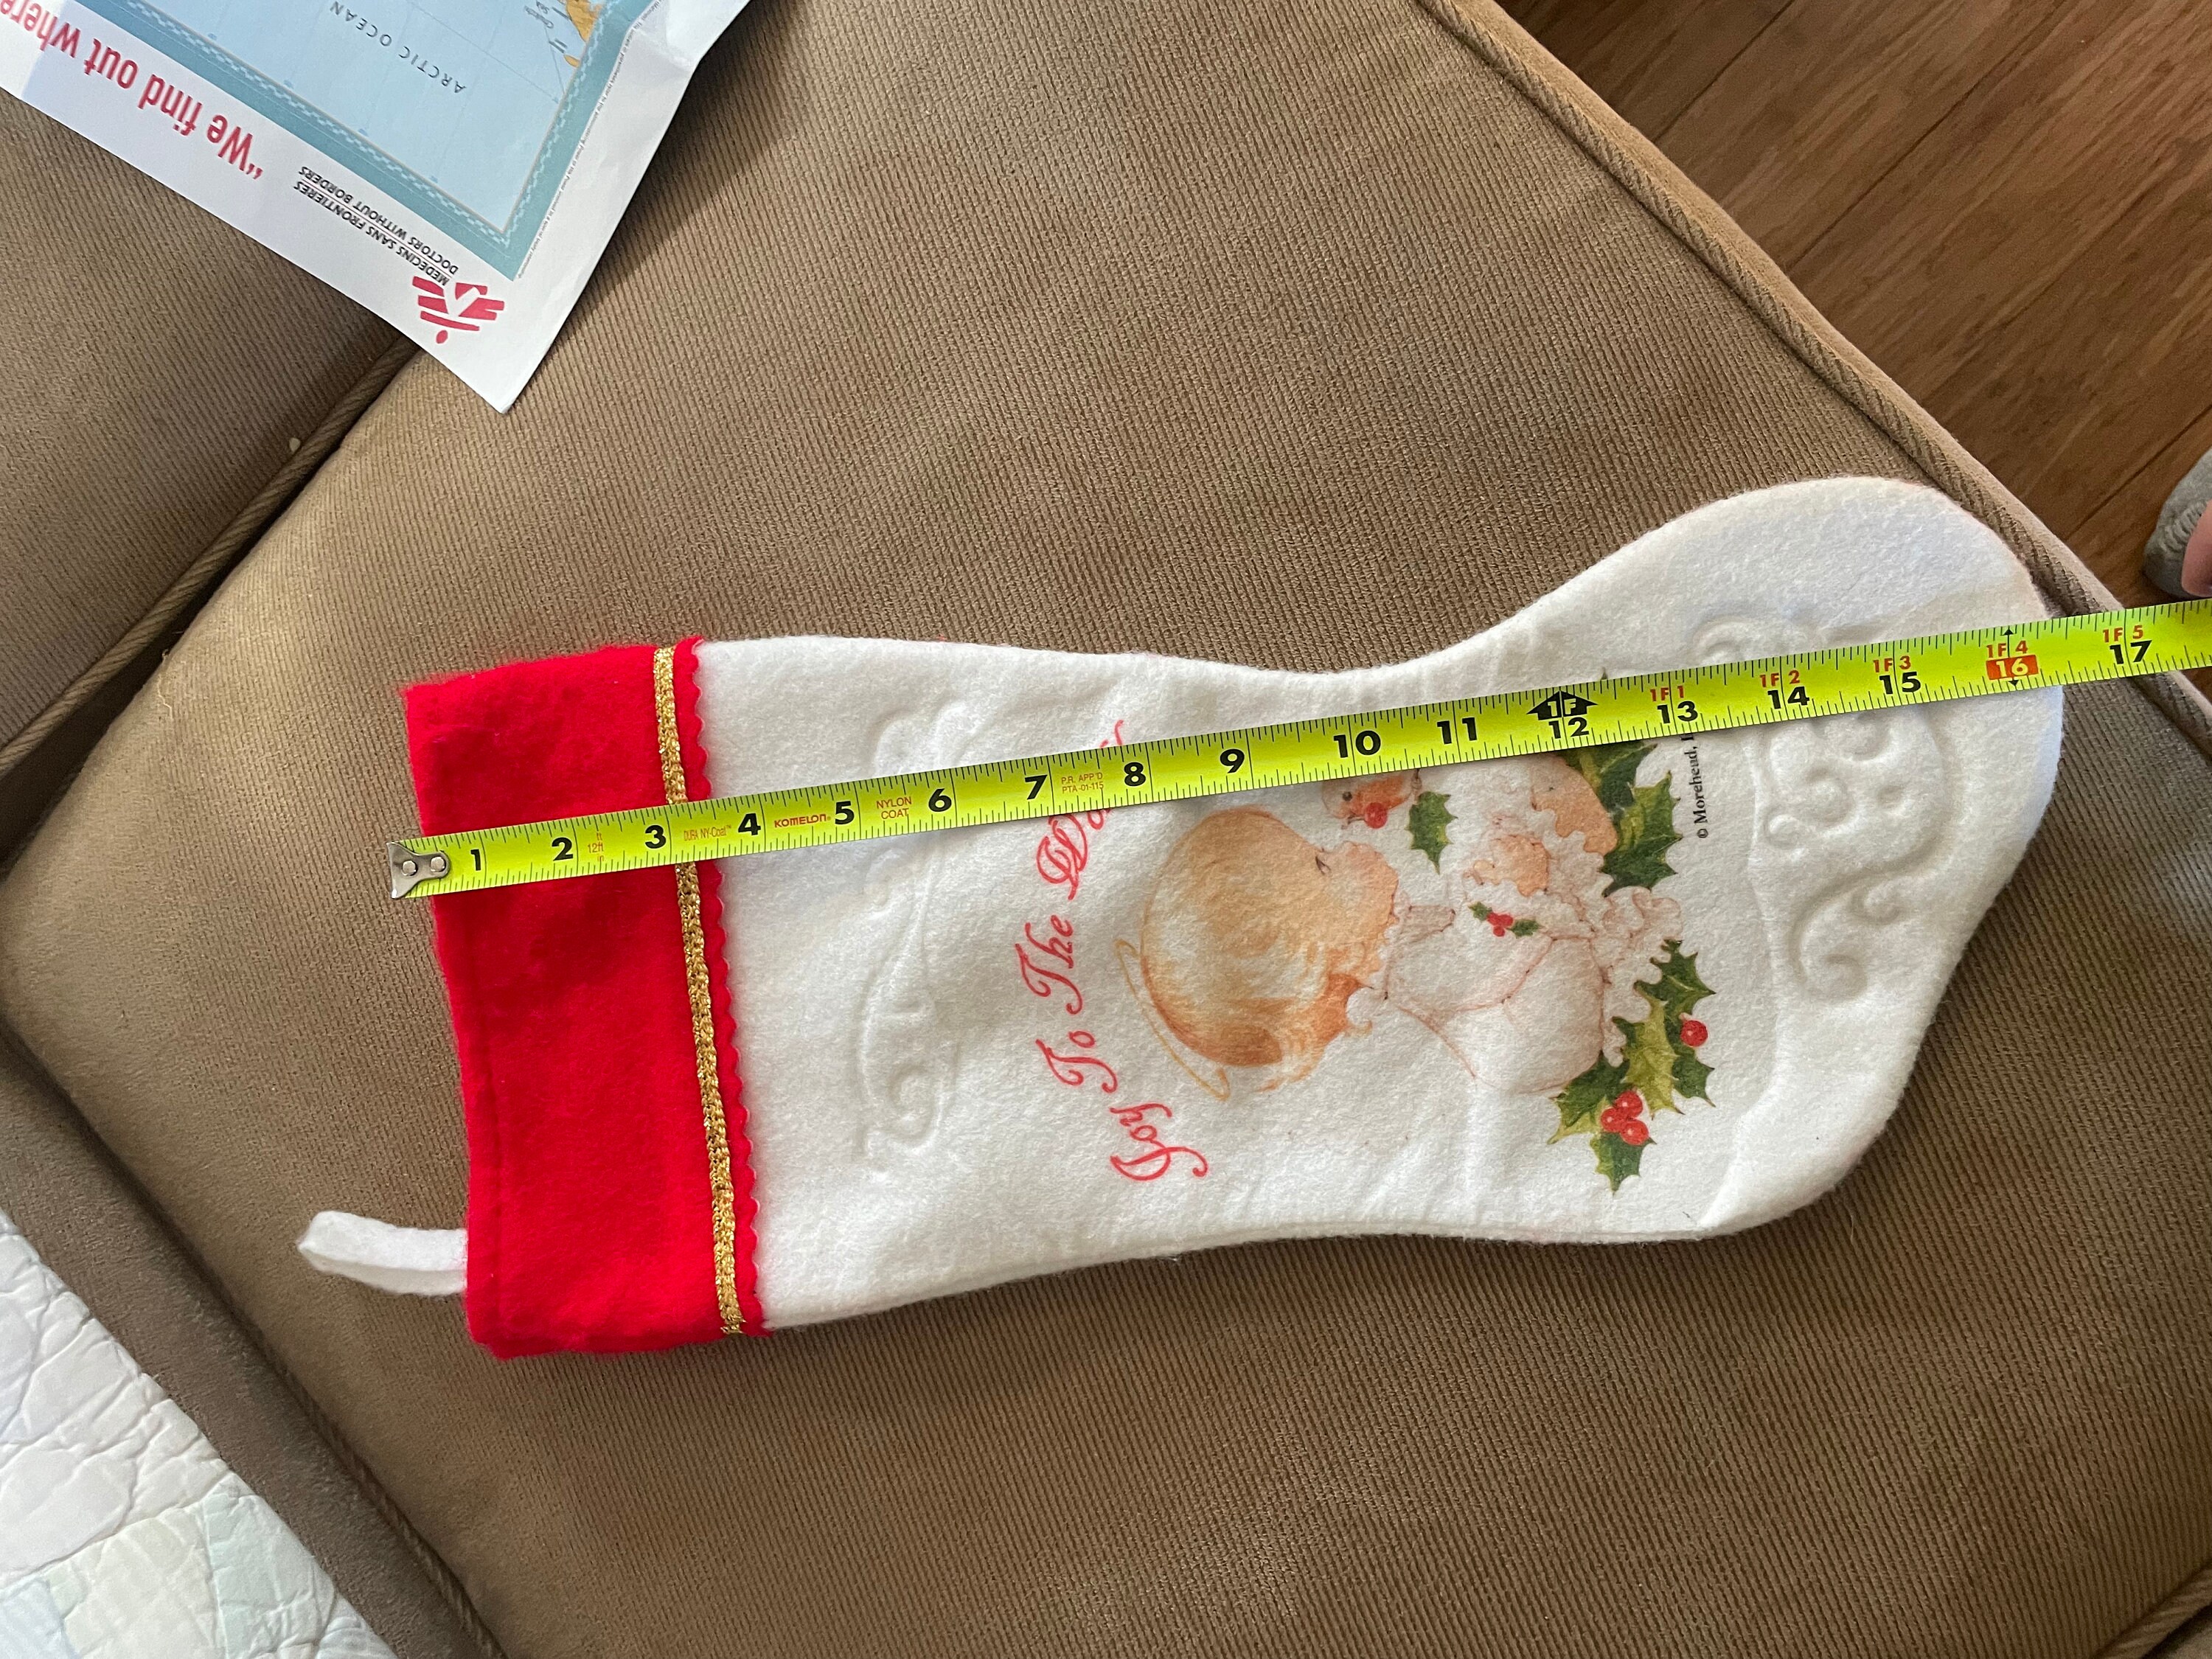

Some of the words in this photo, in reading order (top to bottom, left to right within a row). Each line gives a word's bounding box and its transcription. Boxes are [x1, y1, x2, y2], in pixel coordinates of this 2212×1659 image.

[330, 1, 392, 46] OCEAN
[83, 38, 139, 89] out
[398, 46, 467, 94] ARCTIC
[137, 74, 203, 136] find
[299, 166, 353, 204] BORDERS
[293, 181, 366, 230] FRONTIERES
[352, 201, 407, 240] WITHOUT
[366, 226, 397, 249] SANS
[396, 246, 450, 286] MEDECINS
[407, 237, 459, 275] DOCTORS
[2132, 625, 2143, 639] 5
[2015, 641, 2028, 653] 4
[2110, 640, 2152, 664] 17
[1899, 655, 1911, 669] 3
[1996, 658, 2028, 678] 16
[1788, 670, 1800, 684] 2
[1879, 672, 1921, 695] 15
[1677, 685, 1684, 698] 1
[1767, 686, 1809, 709] 14
[1548, 698, 1576, 717] 1F
[1657, 700, 1698, 724] 13
[1437, 717, 1477, 745] 11
[1548, 717, 1589, 739] 12
[1333, 731, 1381, 758] 10
[1220, 748, 1245, 773] 9
[1124, 762, 1146, 787] 8
[1683, 746, 1708, 824] Morehead,
[1025, 774, 1048, 800] 7
[876, 796, 912, 810] NYLON
[928, 788, 952, 812] 6
[737, 813, 761, 835] 4
[835, 801, 855, 824] 5
[880, 808, 909, 820] COAT
[587, 841, 604, 853] 12ft
[645, 824, 667, 849] 3
[684, 830, 699, 841] DURA
[470, 849, 481, 871] 1
[552, 837, 574, 861] 2
[1015, 914, 1083, 1015] The
[1035, 1030, 1118, 1093] To
[1109, 1102, 1208, 1181] Joy
